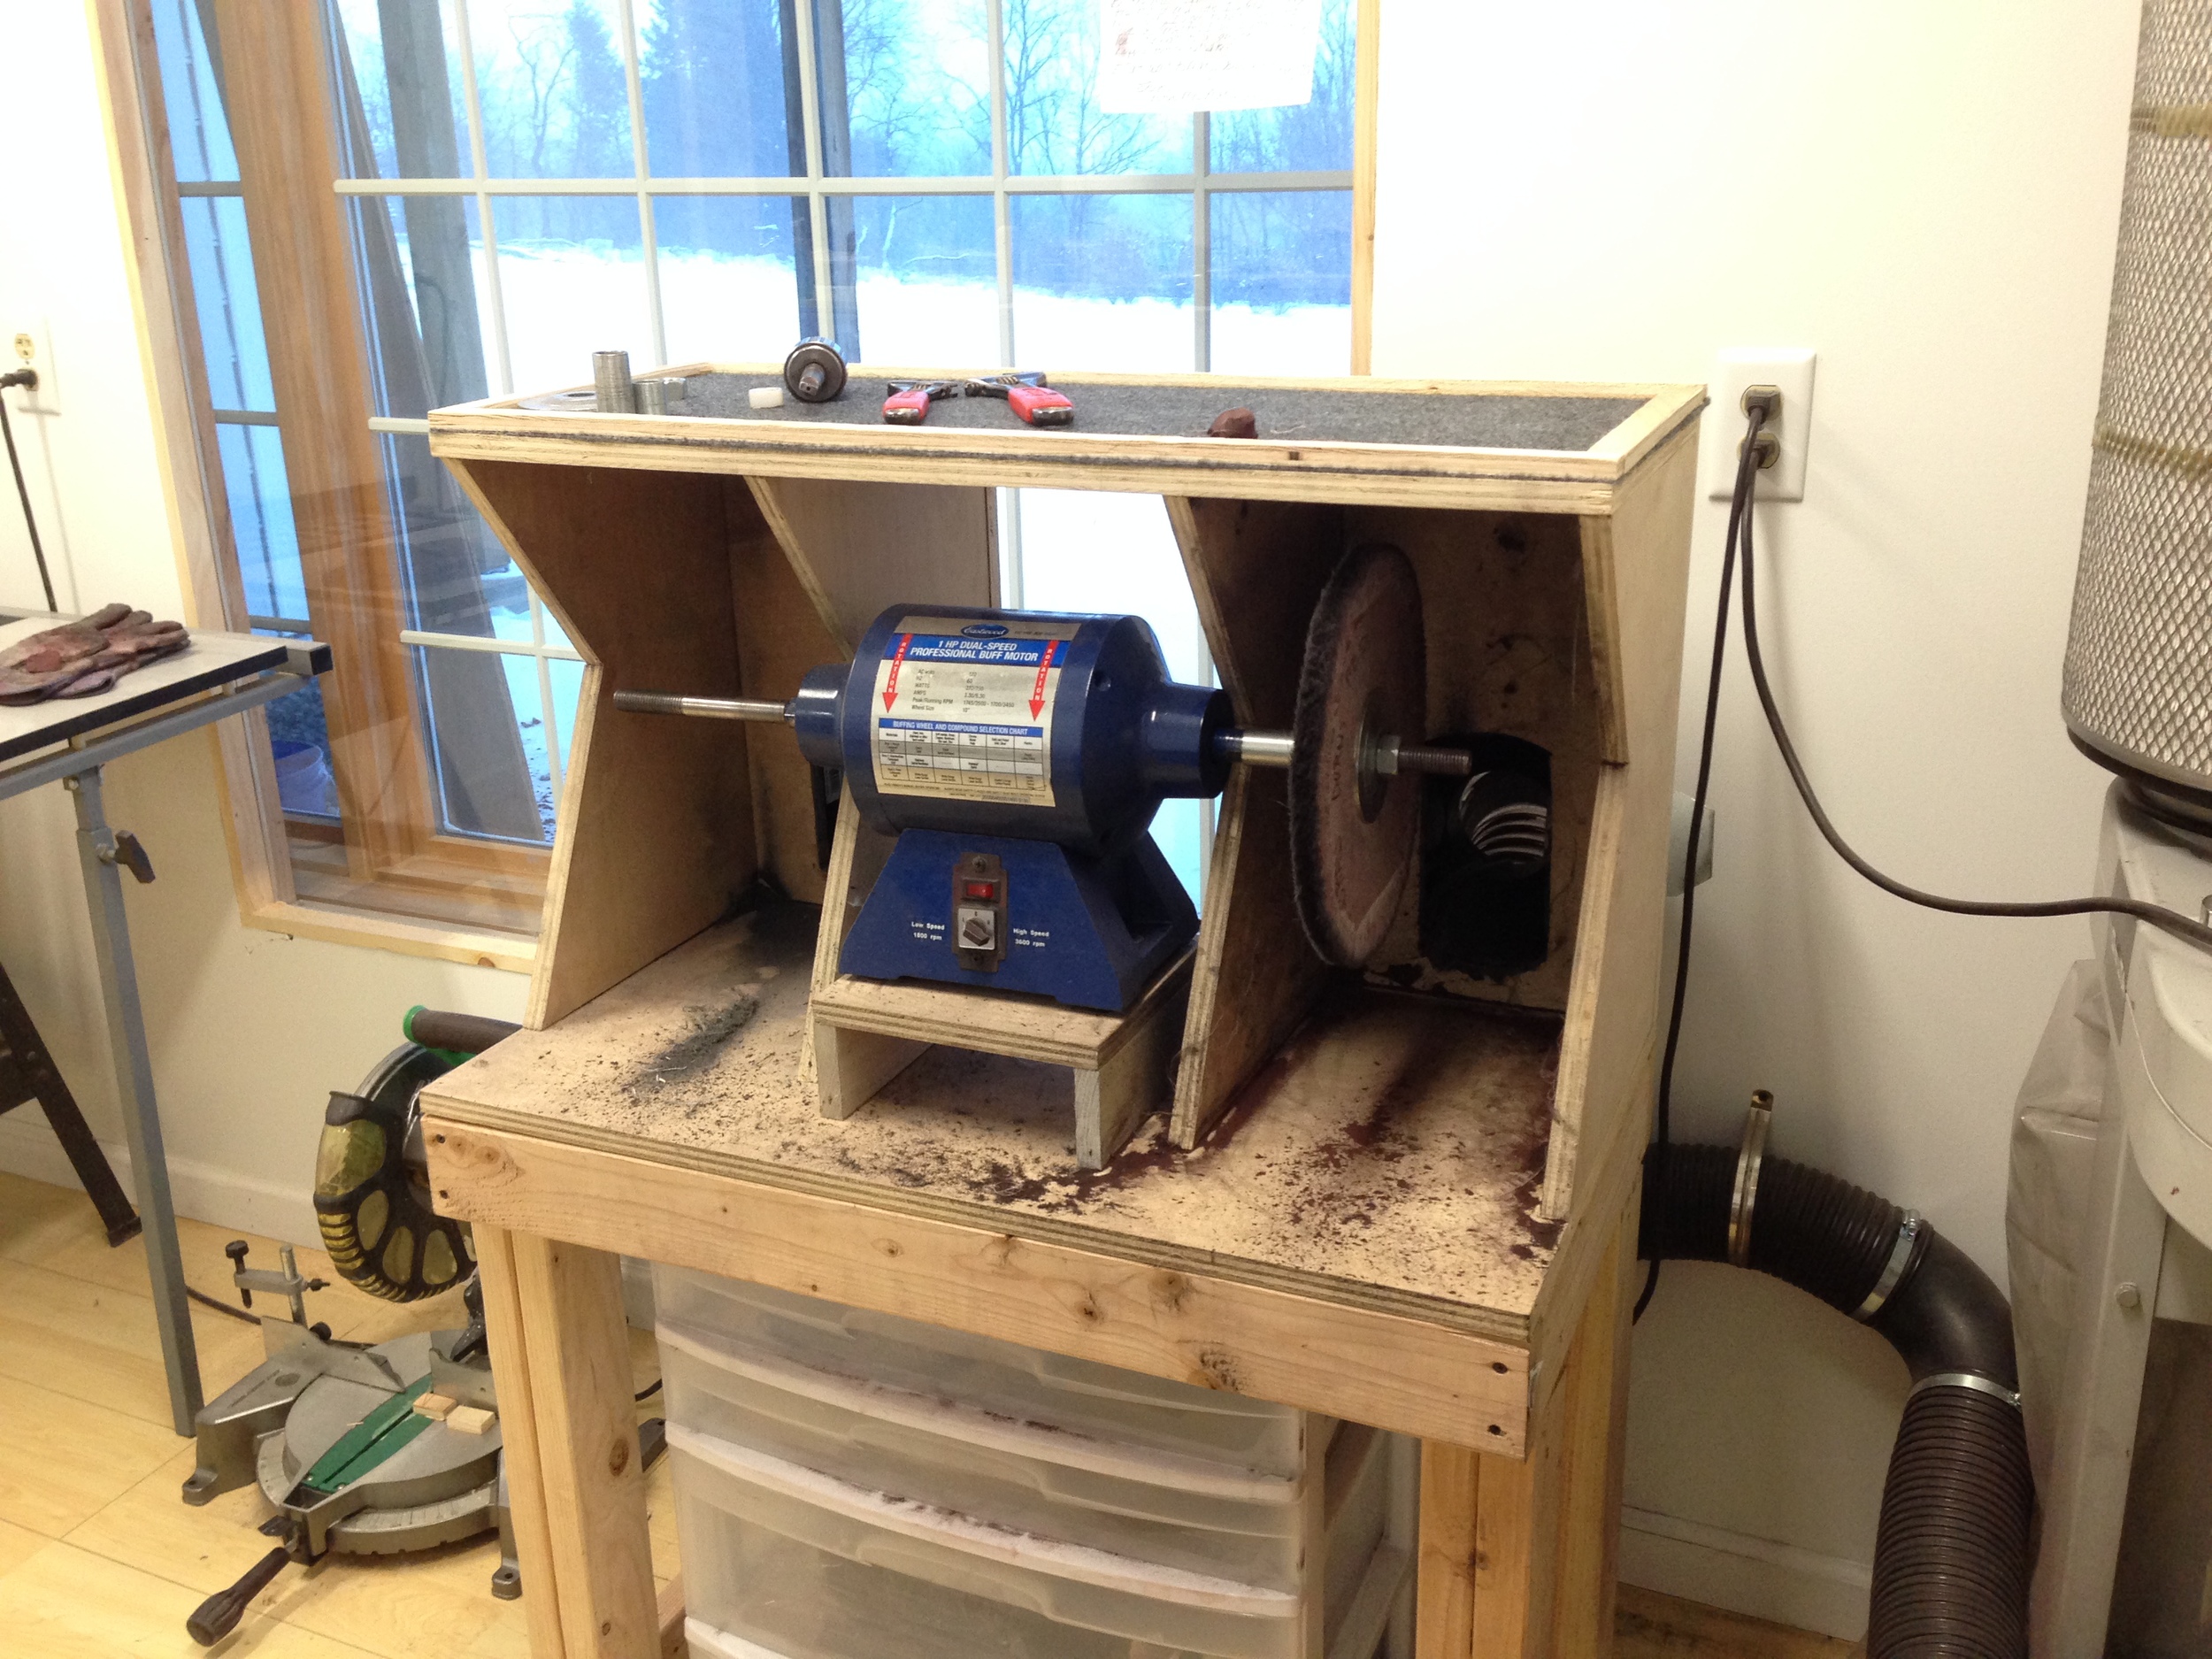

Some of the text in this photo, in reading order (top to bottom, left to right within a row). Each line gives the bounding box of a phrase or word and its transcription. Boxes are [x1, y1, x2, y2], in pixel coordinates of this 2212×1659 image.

[959, 641, 1018, 651] DUAL-SPEED
[910, 647, 1039, 662] PROFESSIONAL BUFF MOTOR
[888, 642, 907, 693] ROTATION
[1034, 649, 1053, 701] ROTATION
[893, 720, 916, 729] BUFFING
[916, 722, 934, 731] WHEEL
[948, 724, 979, 733] COMPOUND
[1013, 927, 1049, 938] High Speed
